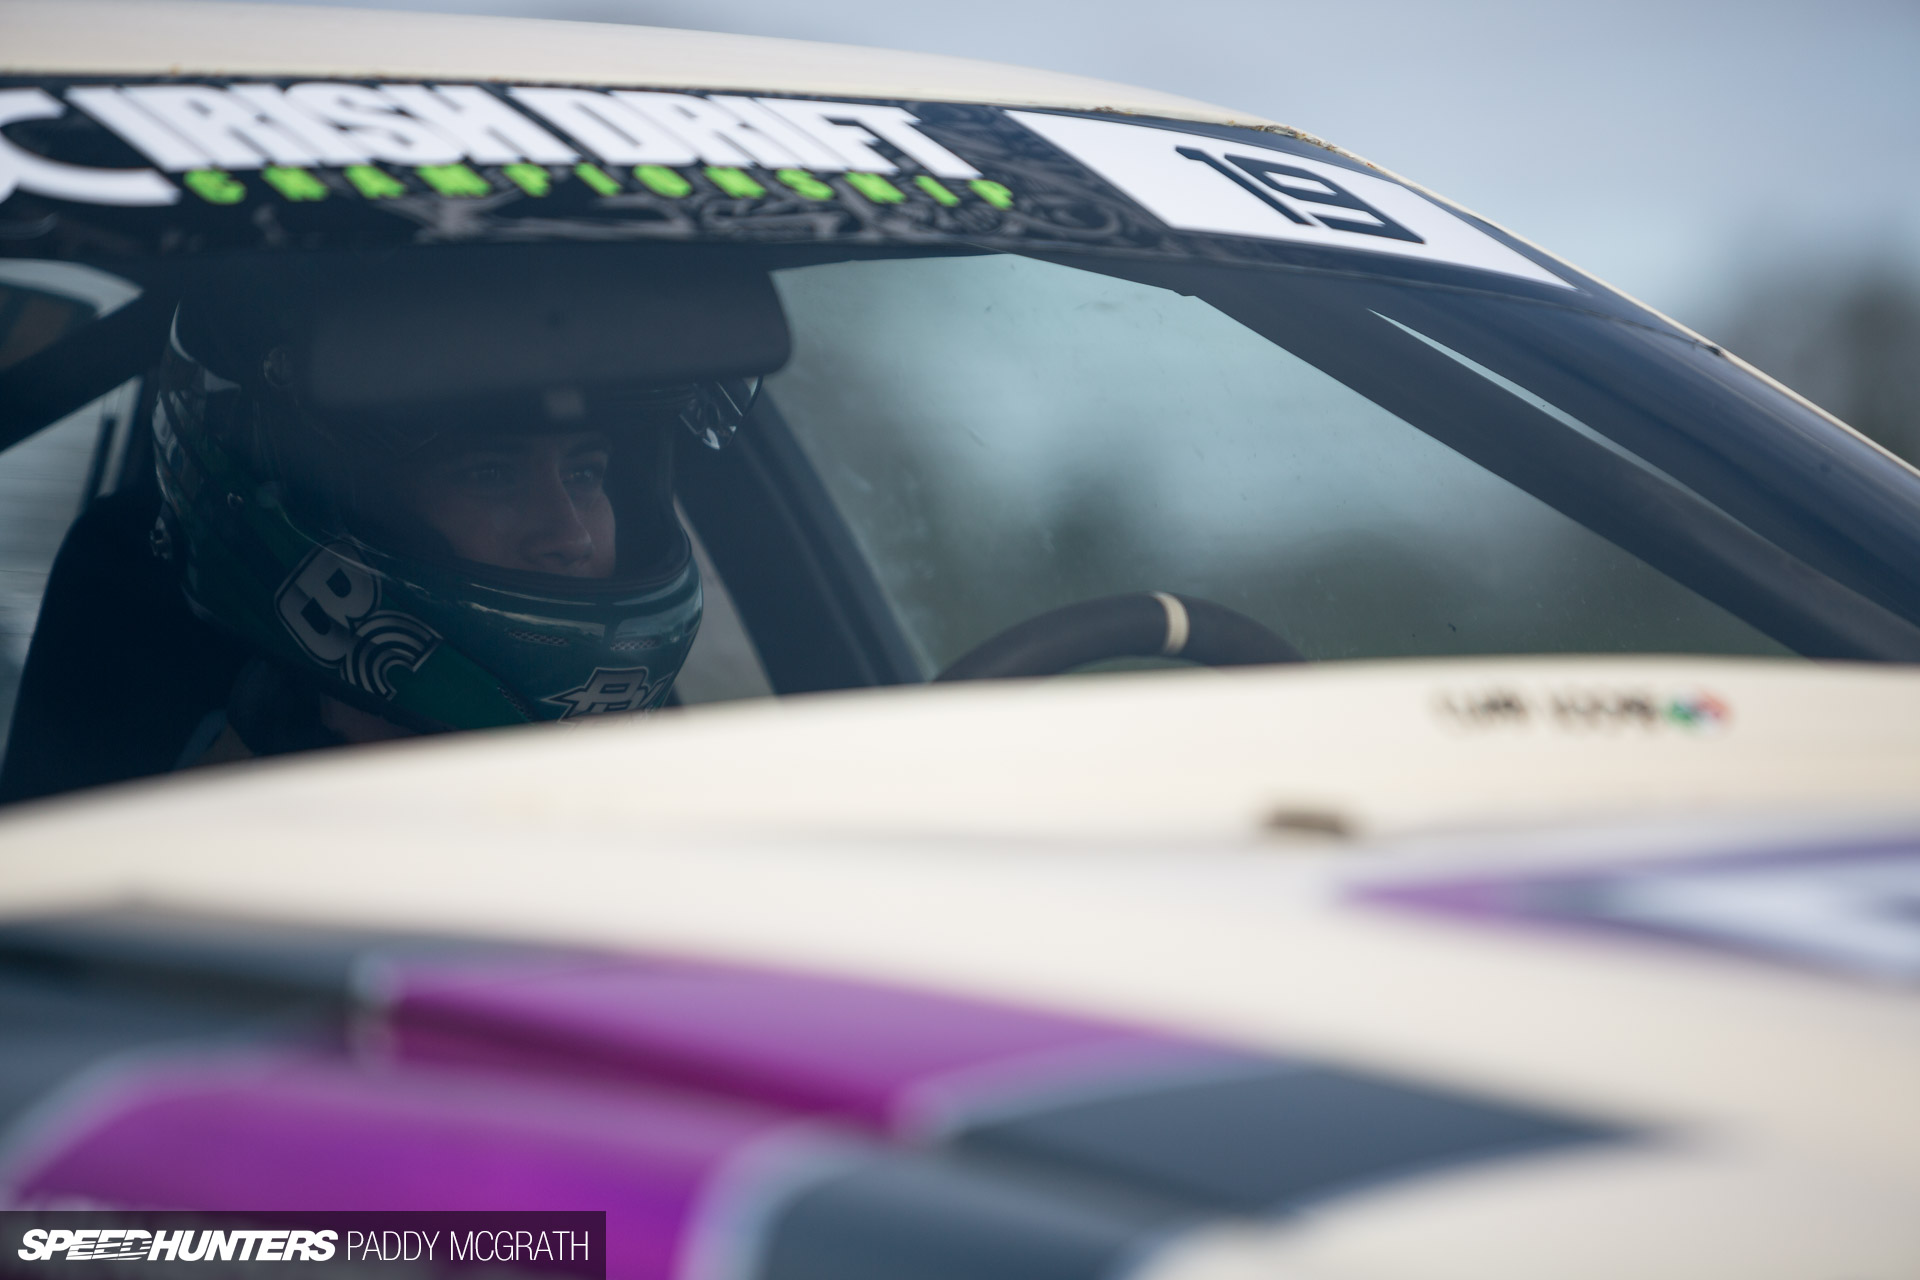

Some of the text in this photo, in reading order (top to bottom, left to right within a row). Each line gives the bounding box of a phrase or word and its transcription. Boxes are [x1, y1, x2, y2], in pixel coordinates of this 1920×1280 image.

[64, 82, 984, 179] IRISH DRIFT
[183, 163, 1014, 210] CHAMPIONSHIP
[1174, 145, 1427, 245] 19
